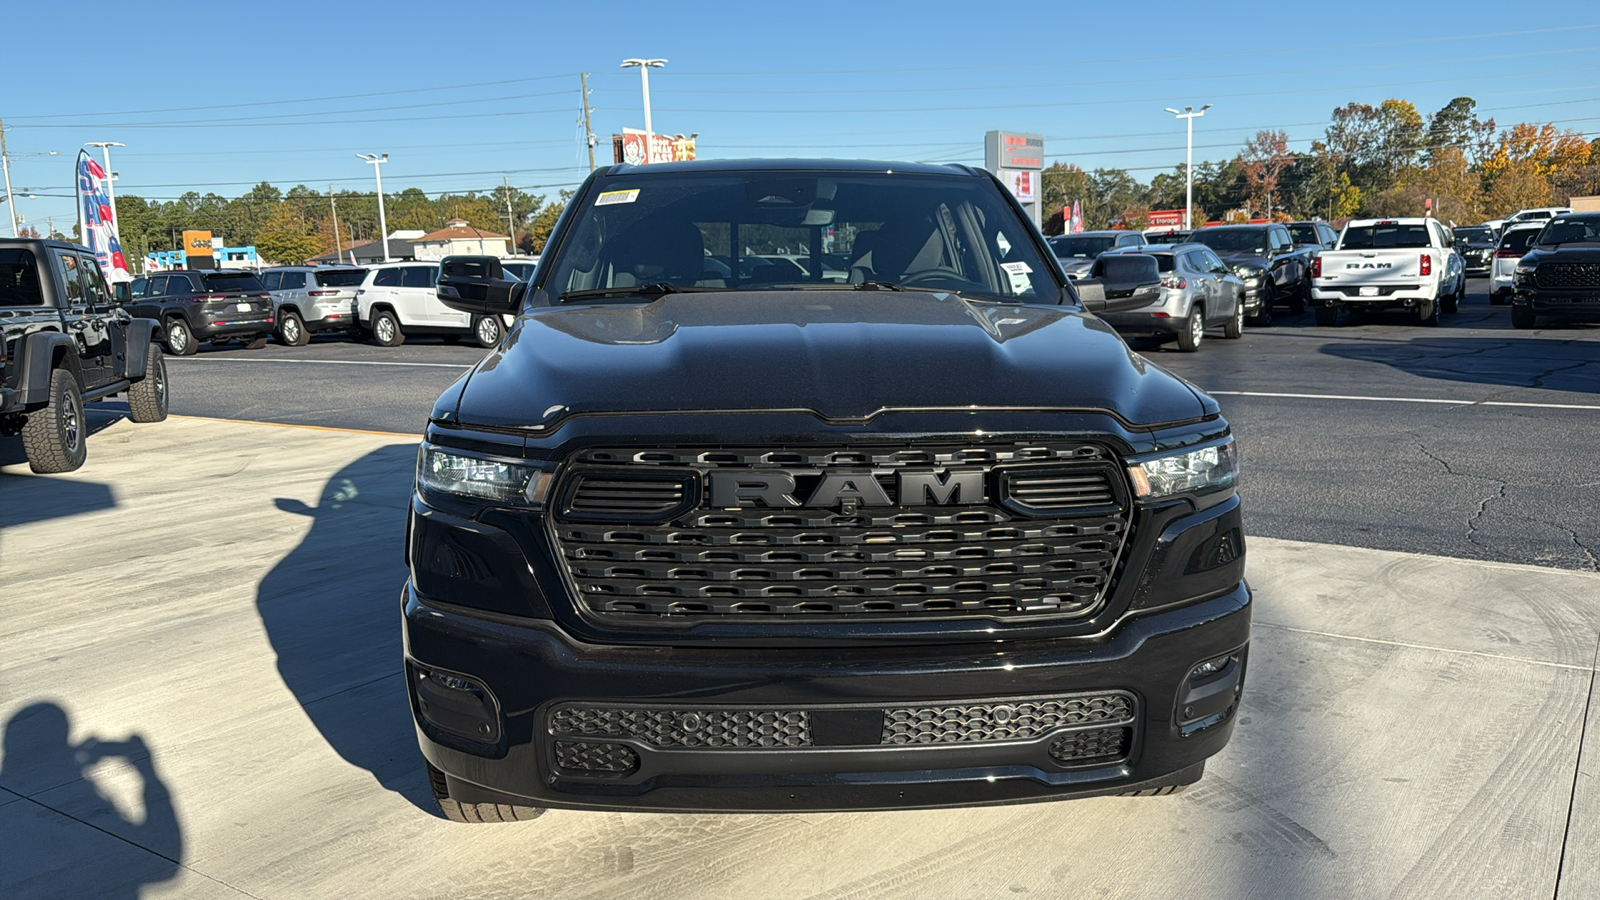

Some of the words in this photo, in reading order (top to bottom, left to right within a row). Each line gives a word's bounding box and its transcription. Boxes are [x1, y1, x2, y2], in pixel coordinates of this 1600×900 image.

[1156, 217, 1178, 225] Storage
[191, 237, 212, 249] Jeep
[709, 469, 985, 507] RAM
